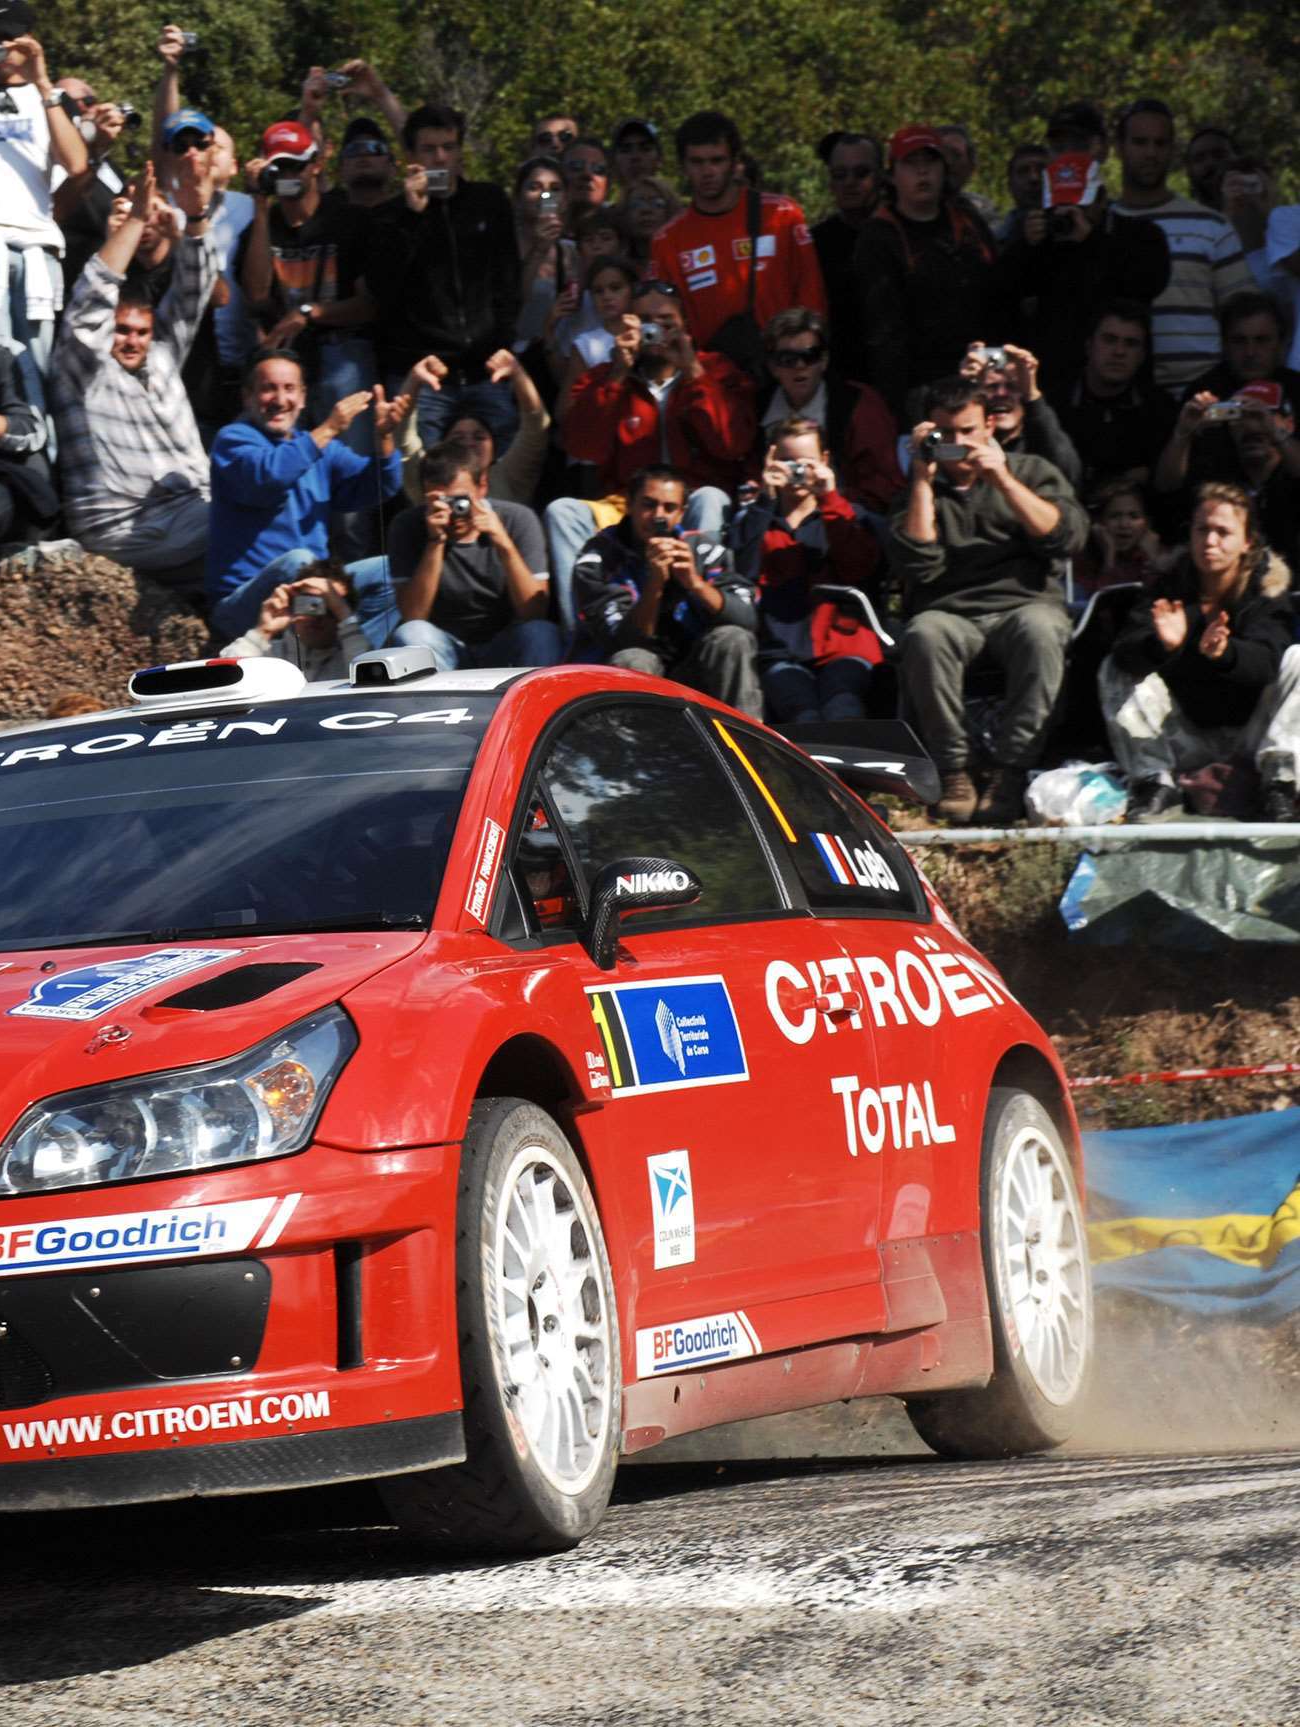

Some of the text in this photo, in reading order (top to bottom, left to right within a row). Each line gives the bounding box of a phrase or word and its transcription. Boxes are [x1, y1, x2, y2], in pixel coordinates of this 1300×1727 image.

[318, 708, 474, 730] C4
[616, 871, 690, 895] NIKKO
[834, 835, 901, 892] Loeb
[653, 1319, 738, 1360] BFGoodrich
[2, 1391, 331, 1450] WWW.CITROEN.COM
